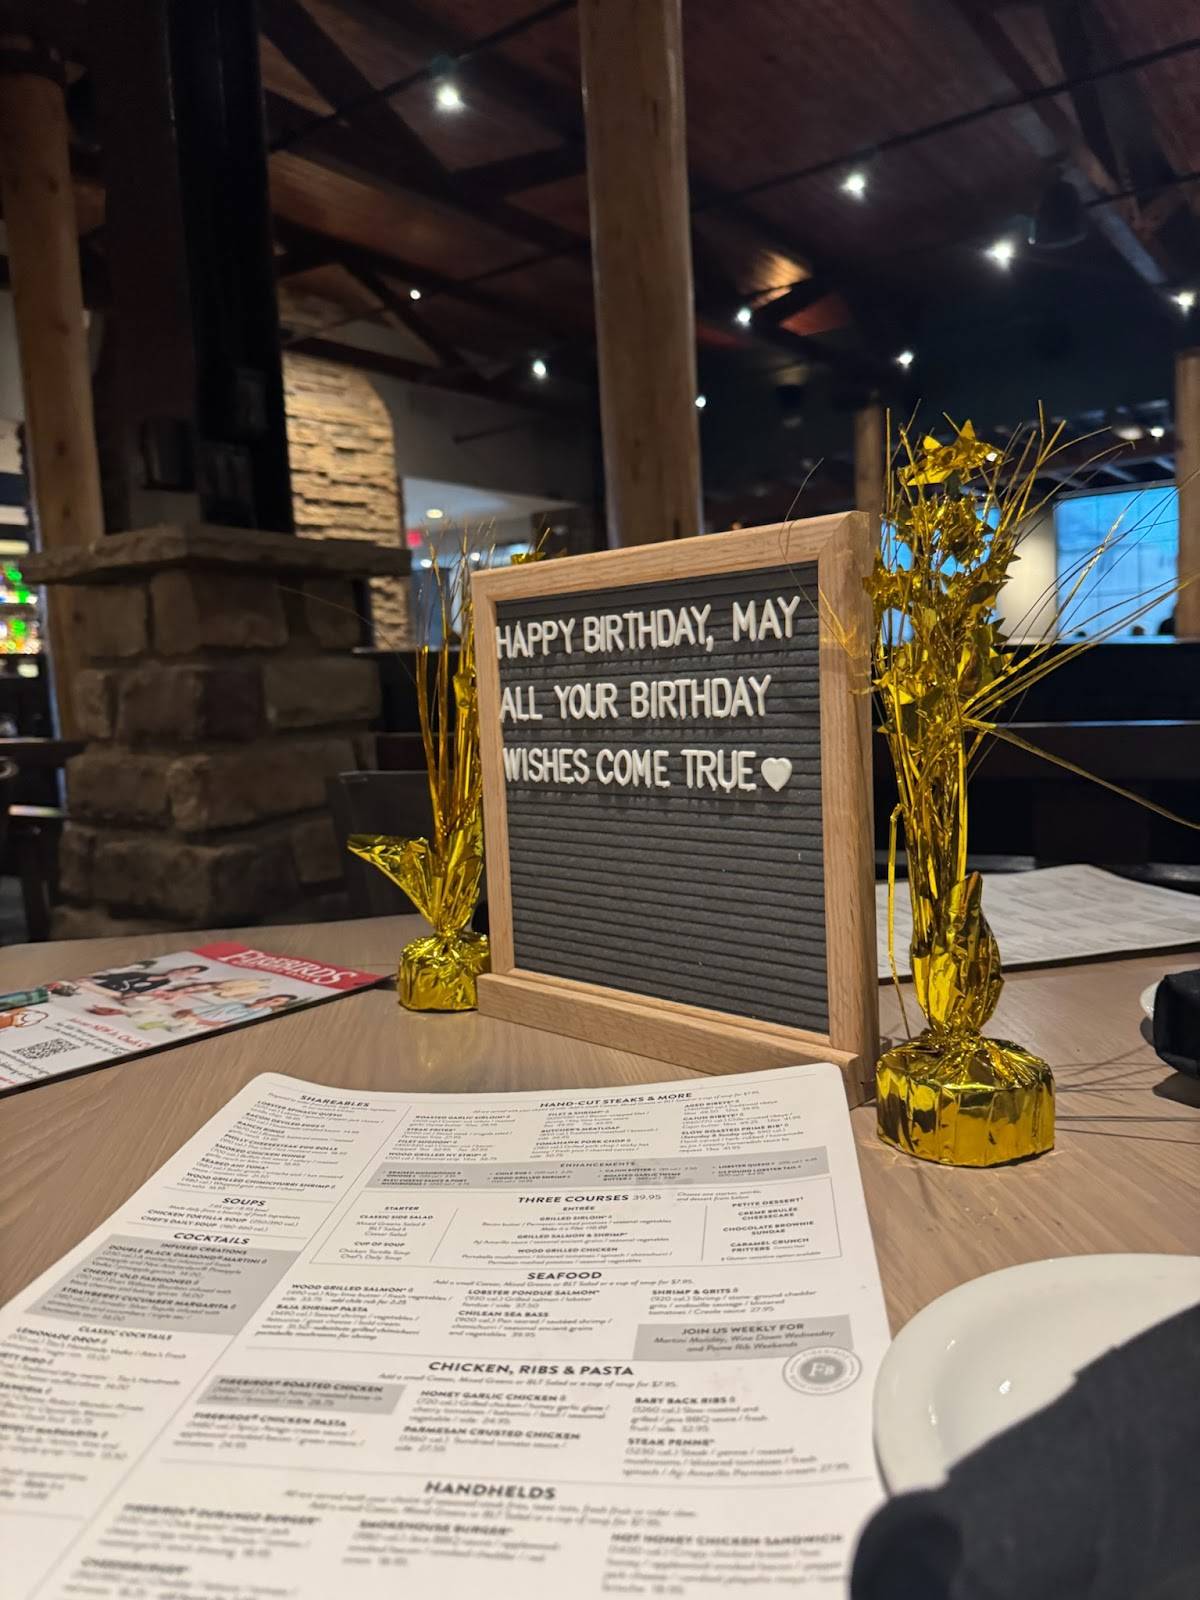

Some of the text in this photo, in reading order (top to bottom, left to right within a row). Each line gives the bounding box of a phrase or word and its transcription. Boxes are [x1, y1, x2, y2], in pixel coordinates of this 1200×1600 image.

[496, 596, 800, 659] HAPPY BIRTHDAY, MAY
[501, 674, 772, 723] ALL YOUR BIRTHDAY
[502, 748, 757, 793] WISHES COME TRUE
[300, 1095, 369, 1107] SHAREABLES
[658, 1092, 692, 1100] MORE
[222, 1198, 266, 1206] SOUPS
[148, 1209, 185, 1217] CHICKEN
[174, 1233, 250, 1245] COCKTAILS
[83, 1268, 118, 1277] CHERRY
[528, 1272, 602, 1280] SEAFOOD
[122, 1294, 174, 1305] CUCUMBER
[175, 1300, 229, 1310] MARGARITA
[78, 1326, 172, 1341] CLASSIC COCKTAILS
[682, 1328, 710, 1336] JOIN
[731, 1325, 776, 1333] WEEKLY
[72, 1336, 101, 1344] DROP
[689, 1336, 728, 1344] Monday,
[785, 1330, 835, 1339] Wednesday
[754, 1342, 797, 1350] Weekends
[428, 1361, 634, 1375] CHICKEN, RIBS & PASTA
[463, 1392, 503, 1400] GARLIC
[314, 1419, 346, 1427] PASTA
[404, 1425, 580, 1440] PARMESAN CRUSTED CHICKEN
[423, 1481, 556, 1500] HANDHELDS
